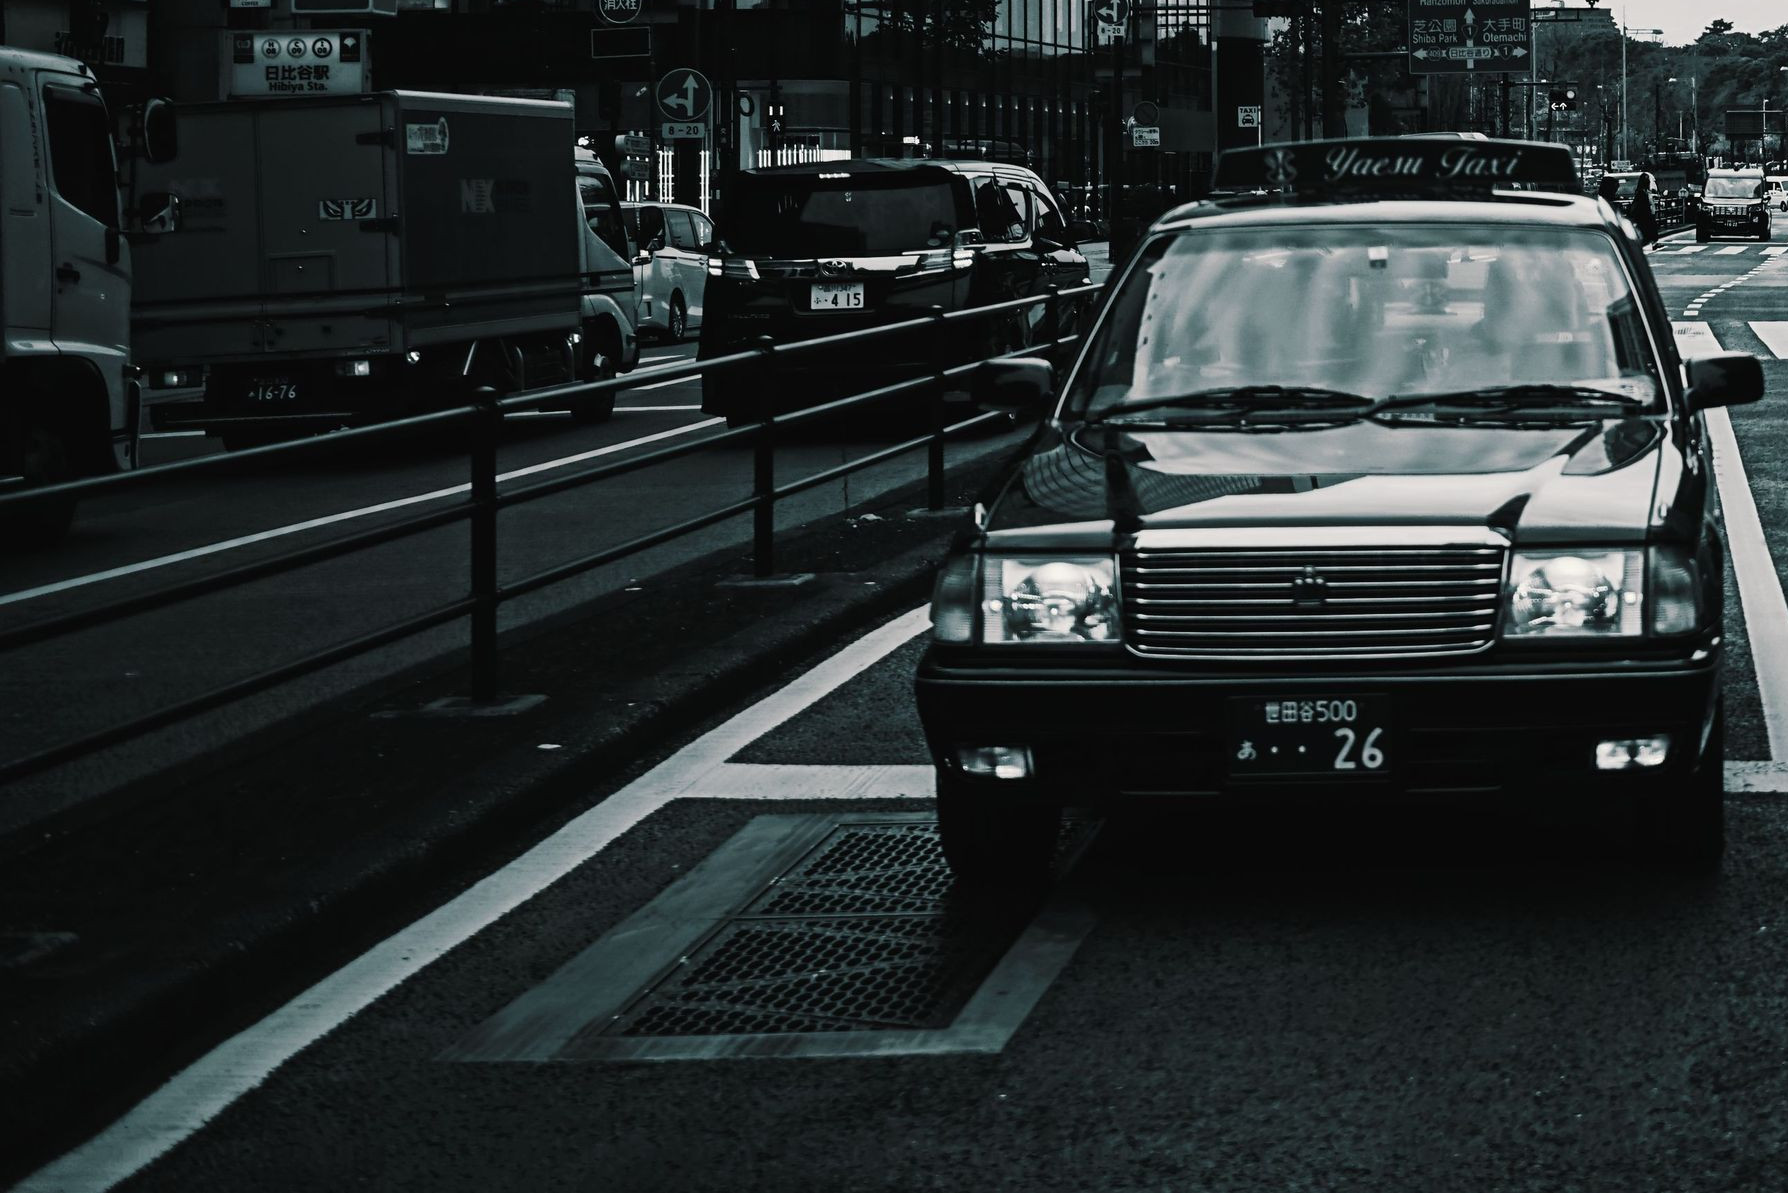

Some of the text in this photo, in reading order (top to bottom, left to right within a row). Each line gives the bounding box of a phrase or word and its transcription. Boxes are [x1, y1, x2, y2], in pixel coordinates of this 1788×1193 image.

[1412, 17, 1526, 34] 芝公園 大手町
[1412, 32, 1527, 45] Shiba Park Otemachi
[291, 47, 302, 55] 09
[1450, 49, 1491, 58] 日比谷通り
[265, 64, 330, 81] 日比谷駅
[269, 81, 328, 93] Hibiya Sta.
[1323, 145, 1523, 183] Yaesu Taxi
[258, 384, 297, 401] 16-76
[1236, 726, 1385, 770] あ 26
